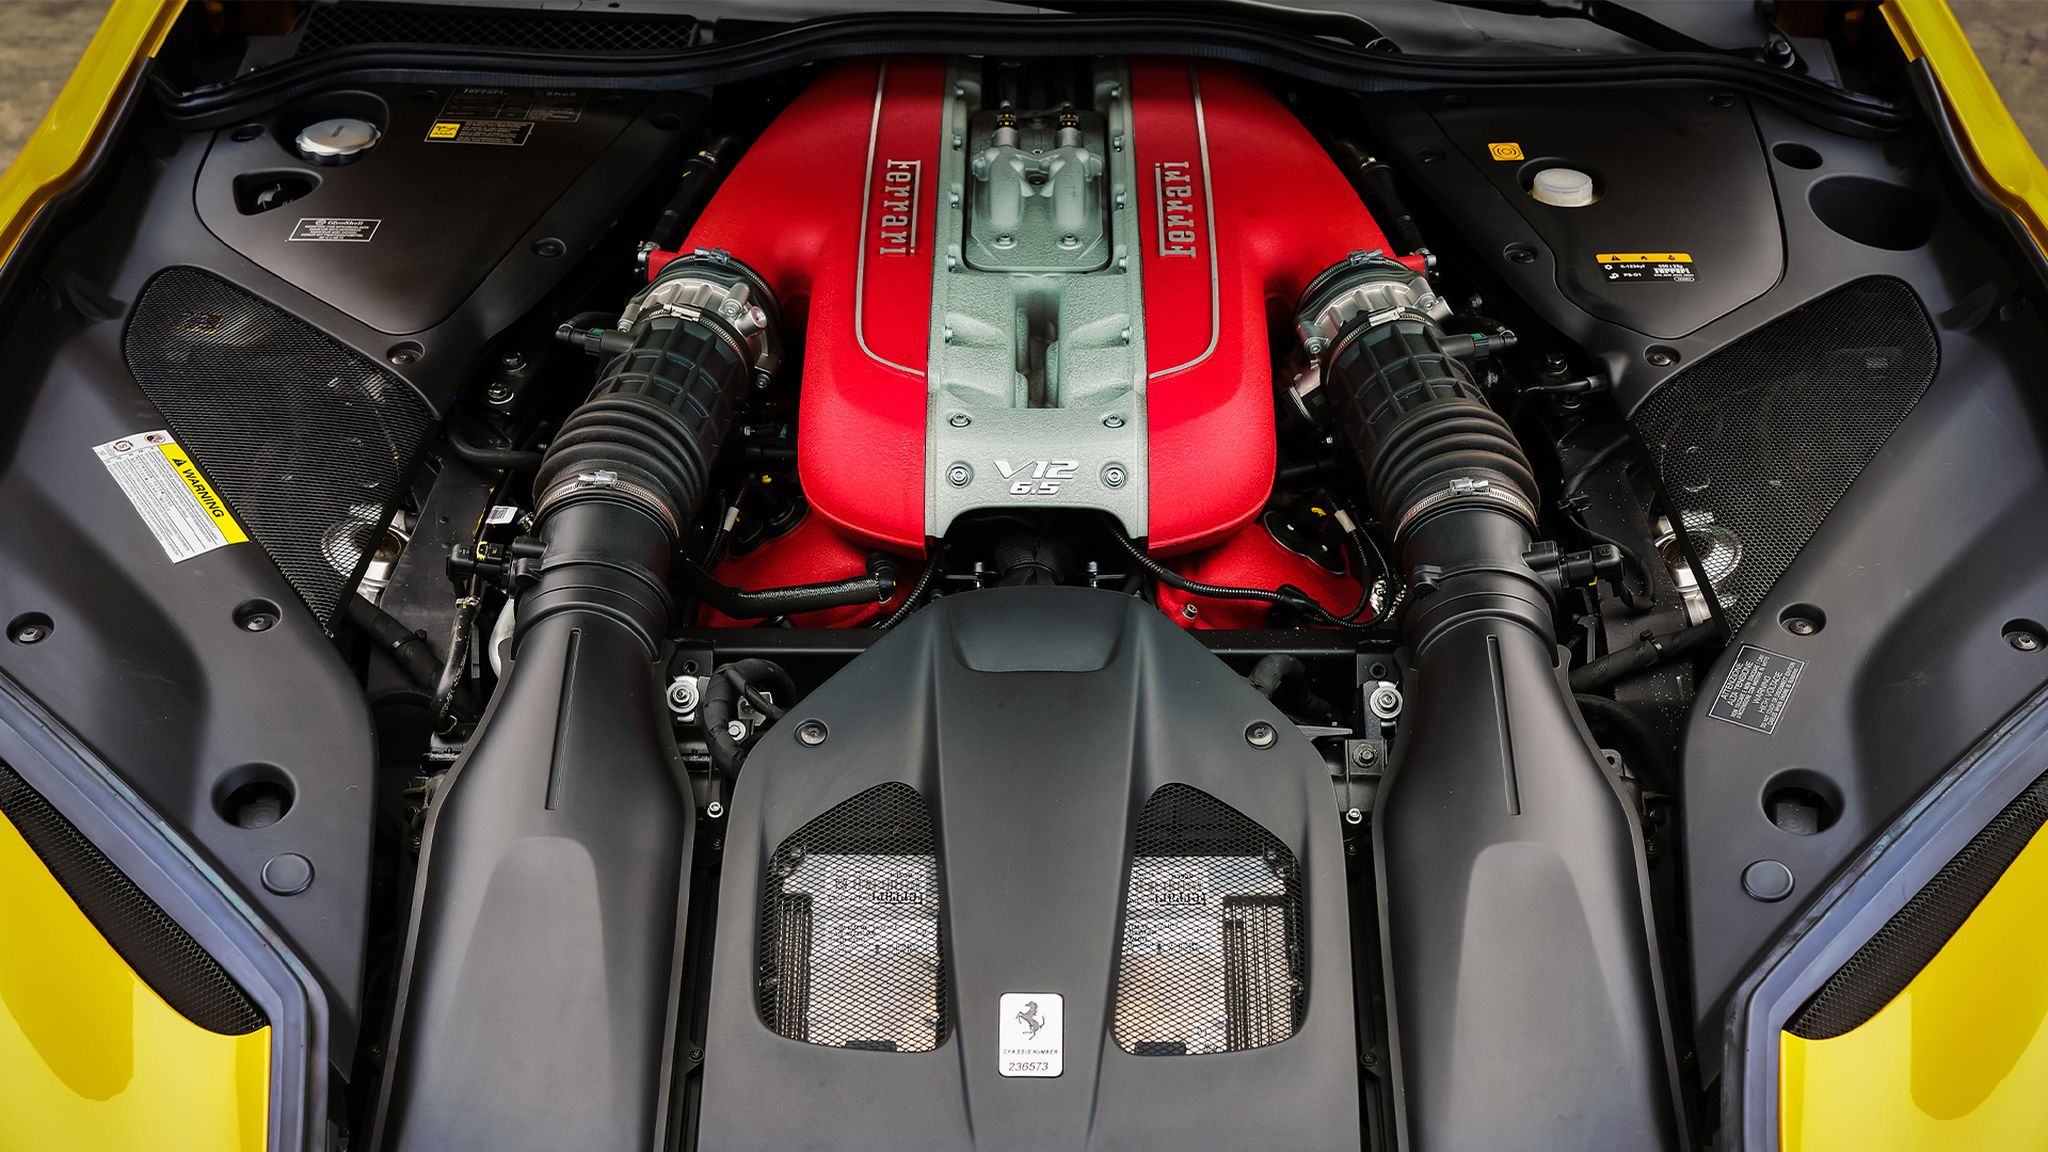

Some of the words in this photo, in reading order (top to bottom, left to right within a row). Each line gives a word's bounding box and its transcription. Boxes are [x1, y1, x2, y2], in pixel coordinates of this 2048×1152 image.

[880, 159, 921, 254] Ferrari
[1155, 161, 1197, 257] Ferrari
[993, 460, 1080, 479] V12
[1009, 481, 1060, 496] 6.5
[183, 468, 225, 518] WARNING
[1721, 662, 1743, 700] ATTENZIONE
[1727, 691, 1738, 706] ALTA
[1733, 661, 1754, 691] TENSIONE
[1752, 675, 1771, 704] WARNING
[1758, 697, 1770, 713] HIGH
[1765, 671, 1783, 697] VOLTAGE
[1008, 1062, 1049, 1071] 236573
